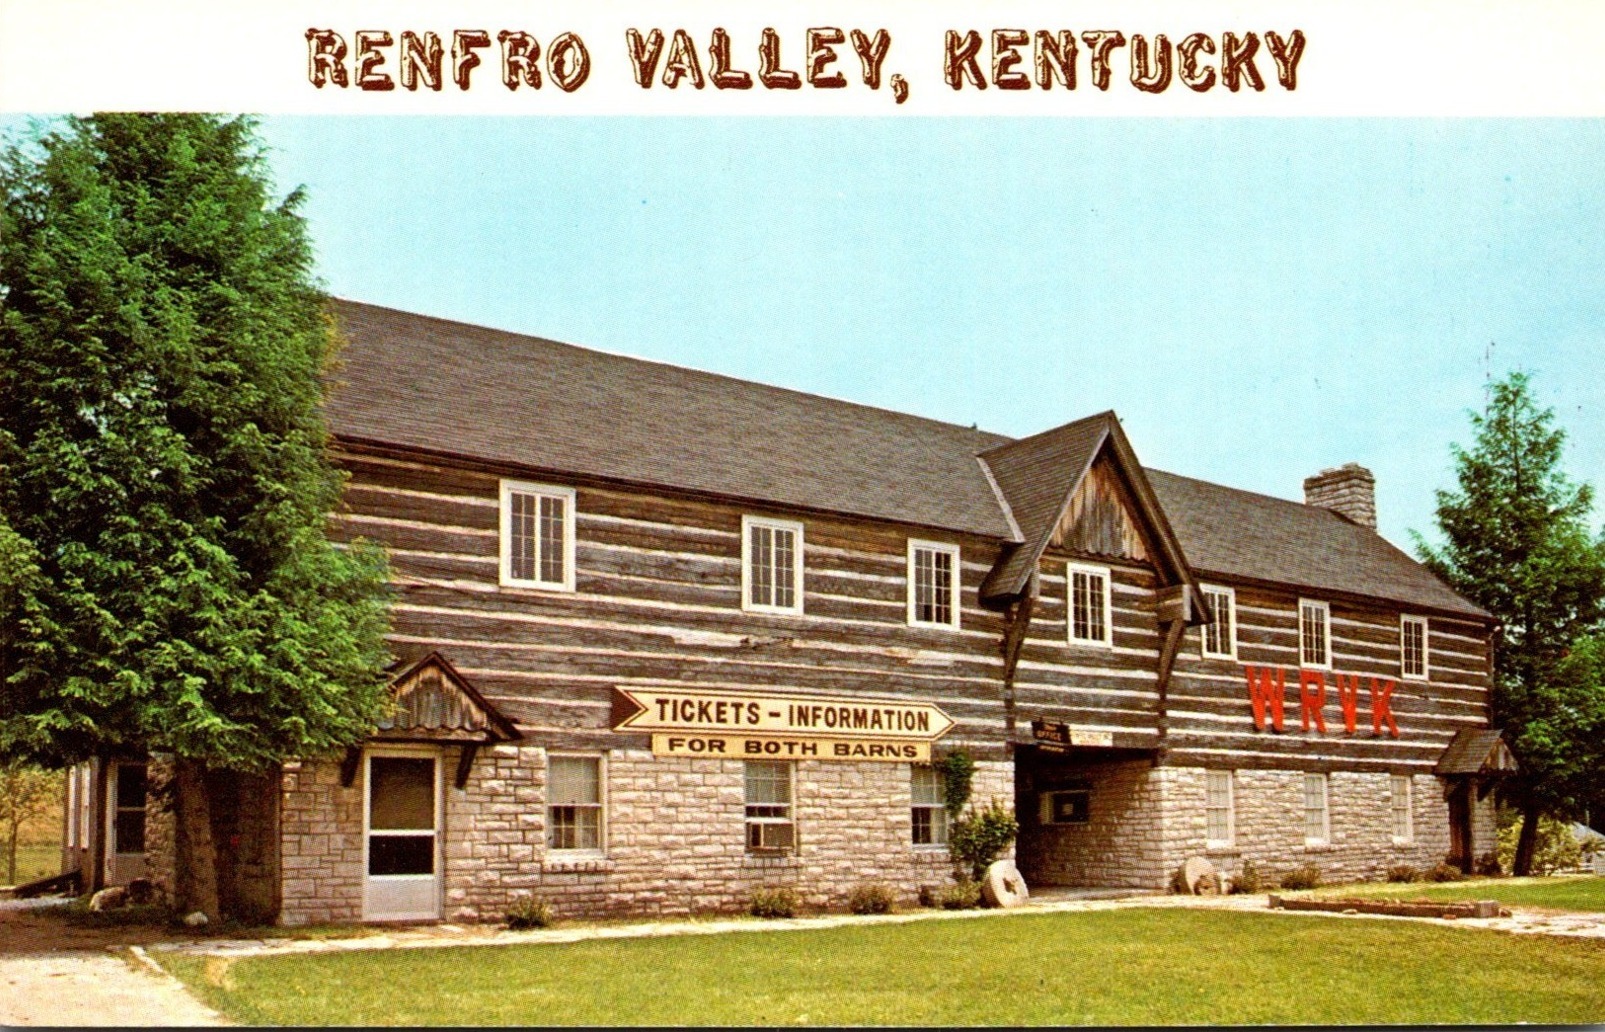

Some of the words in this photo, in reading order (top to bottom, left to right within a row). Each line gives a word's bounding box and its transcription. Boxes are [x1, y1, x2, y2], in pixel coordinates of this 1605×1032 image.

[655, 698, 760, 725] TICKETS
[788, 704, 929, 731] INFORMATION
[1245, 665, 1400, 738] WRVK
[668, 737, 726, 753] FOR
[744, 740, 818, 755] BOTH
[833, 743, 918, 758] BARNS
